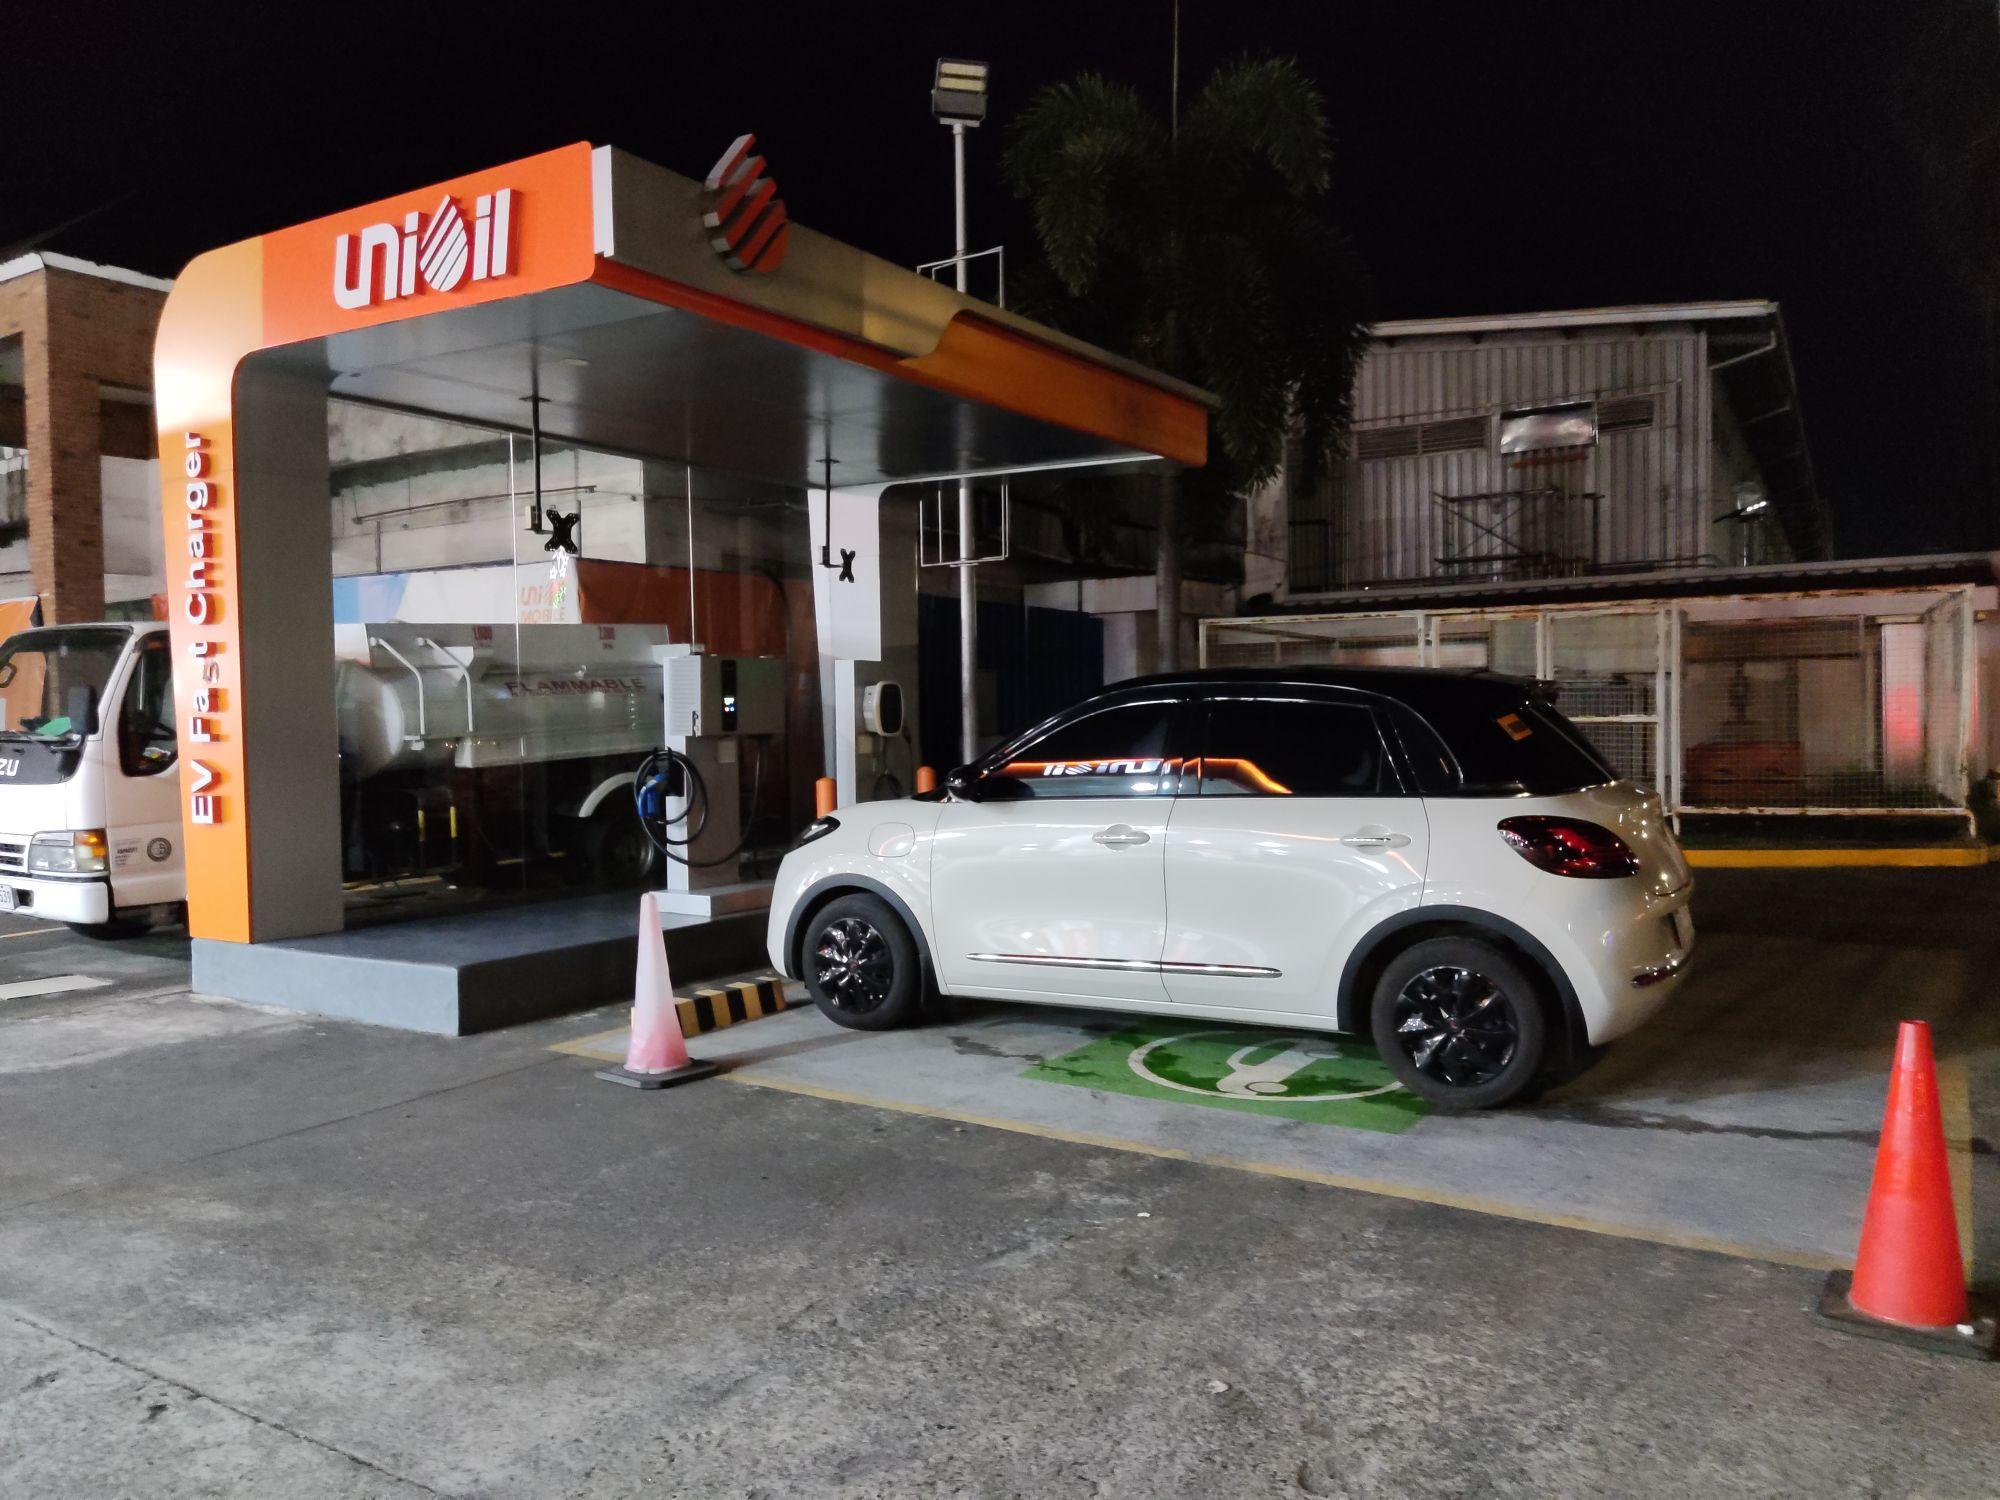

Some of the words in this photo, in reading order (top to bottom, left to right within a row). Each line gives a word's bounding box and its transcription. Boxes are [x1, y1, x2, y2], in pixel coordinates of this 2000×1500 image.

[184, 431, 210, 626] Charger
[188, 641, 220, 743] Fast
[504, 678, 647, 693] FLAMMABLE
[190, 758, 214, 824] EV
